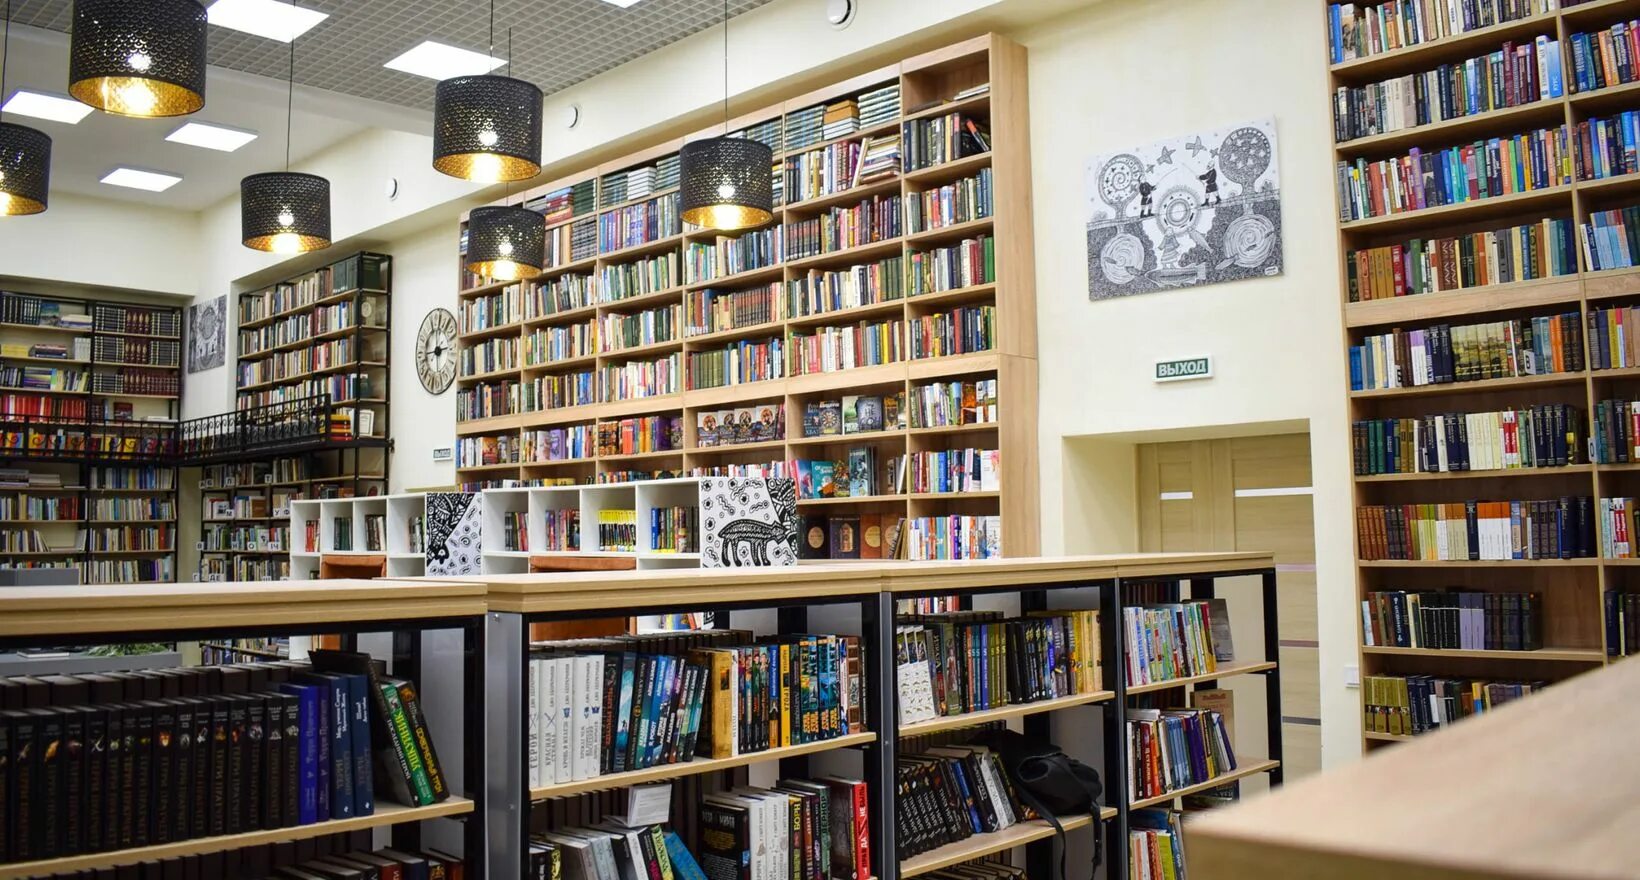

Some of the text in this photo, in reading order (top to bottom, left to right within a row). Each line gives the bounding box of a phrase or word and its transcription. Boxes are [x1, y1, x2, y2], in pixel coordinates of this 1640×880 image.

[1158, 360, 1206, 376] ВЫХОД
[394, 712, 421, 772] УШКУЙНИК
[432, 776, 443, 793] ТРОН
[793, 803, 801, 831] БОРН
